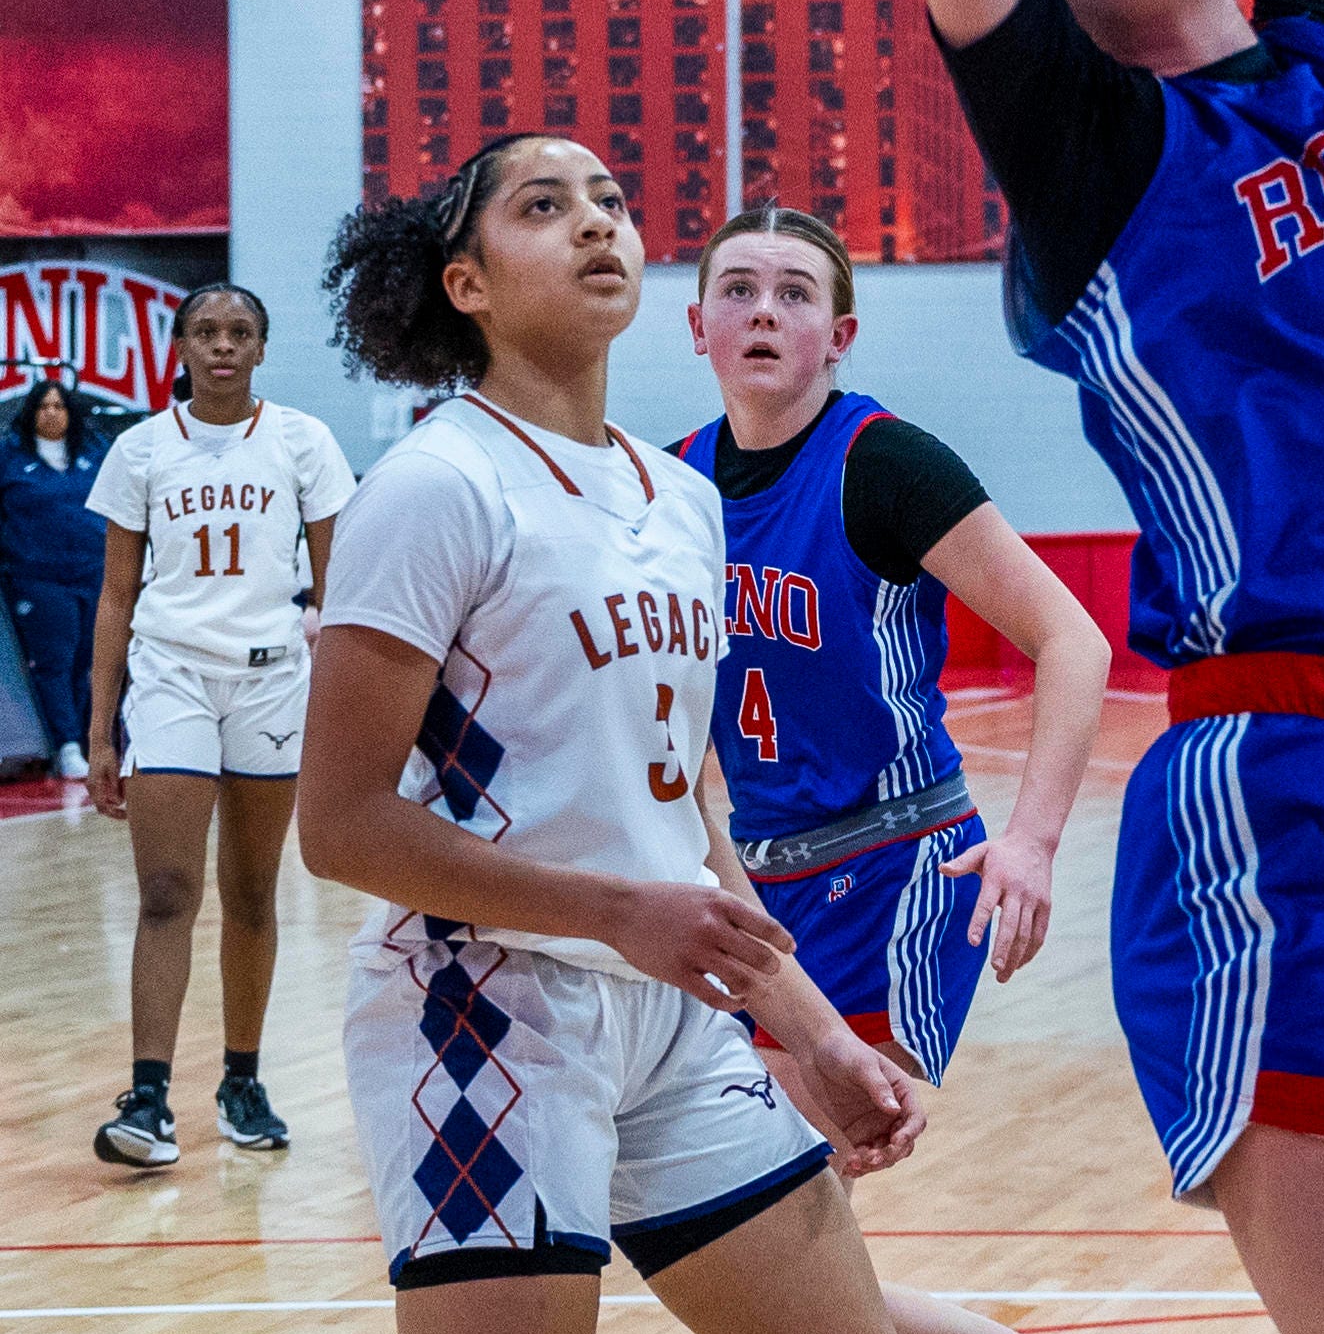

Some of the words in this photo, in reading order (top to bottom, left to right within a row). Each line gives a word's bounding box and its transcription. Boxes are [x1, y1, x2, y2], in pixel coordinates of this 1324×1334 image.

[165, 484, 276, 521] LEGACY
[193, 523, 245, 578] 11
[569, 590, 718, 671] LEGAC
[725, 564, 822, 652] NO
[738, 668, 779, 763] 4
